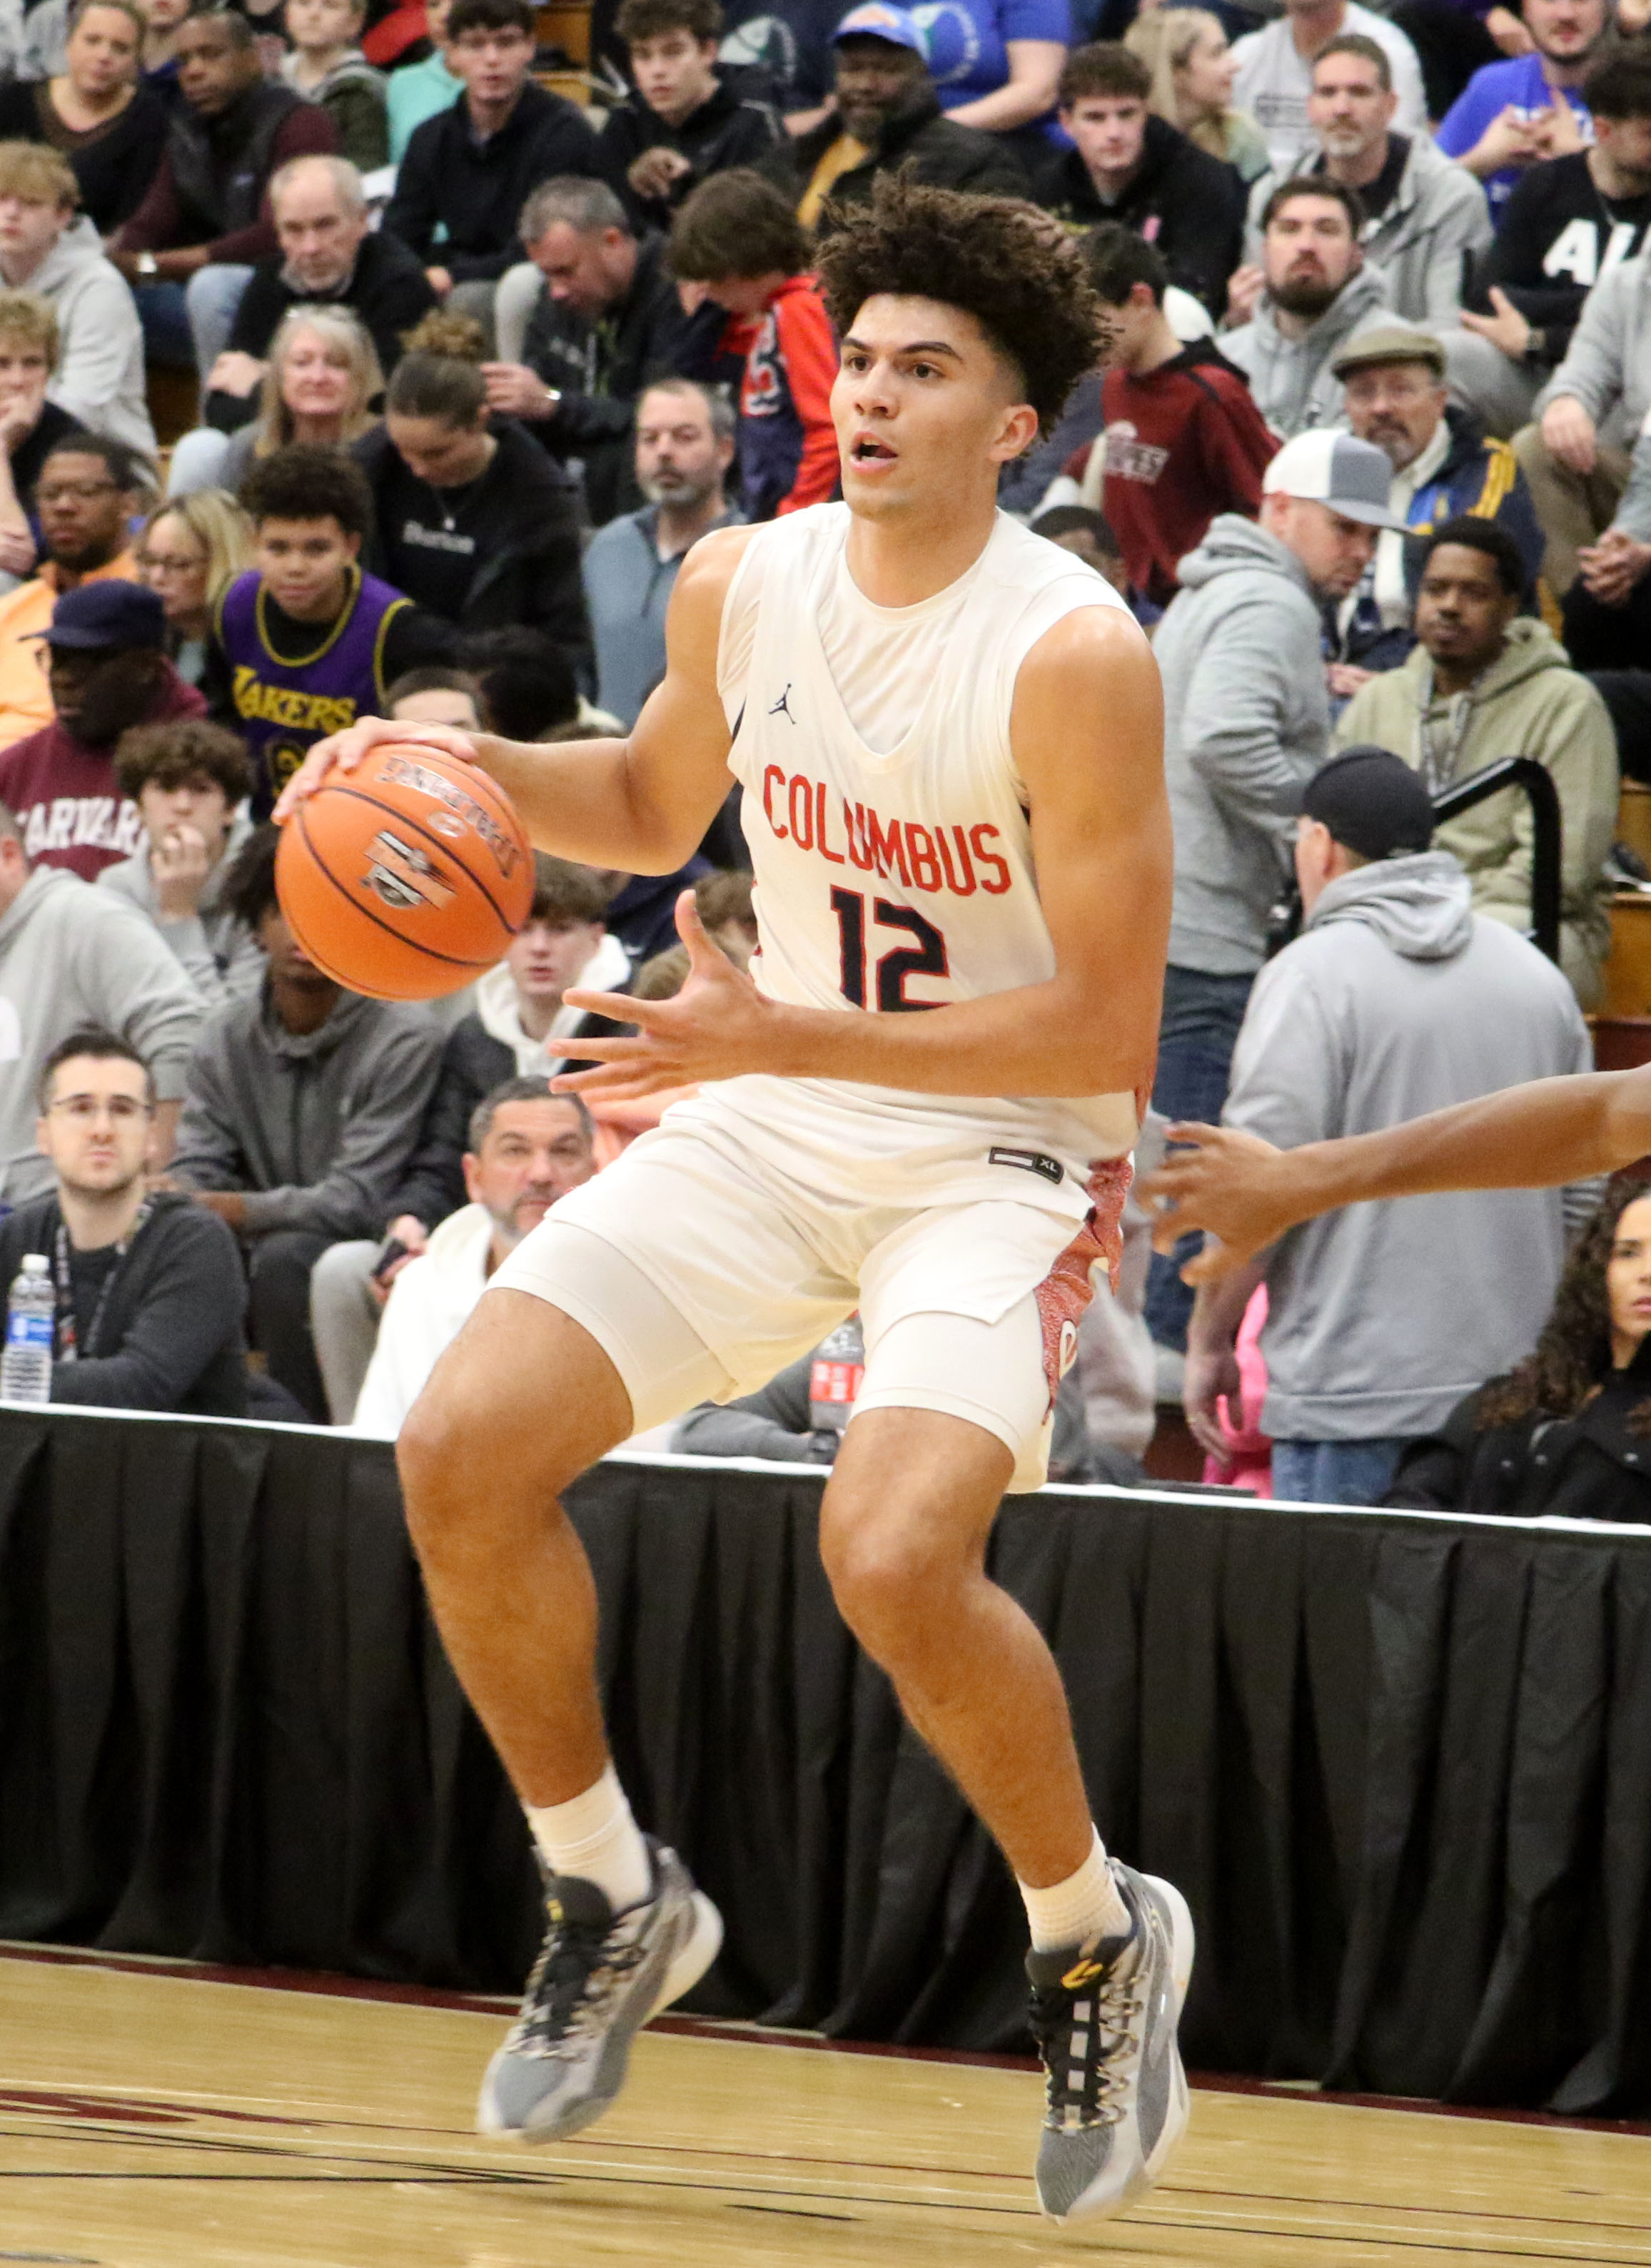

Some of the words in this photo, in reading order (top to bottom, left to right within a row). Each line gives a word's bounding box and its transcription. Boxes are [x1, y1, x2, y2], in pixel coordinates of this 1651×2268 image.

[233, 665, 355, 736] LAKERS
[15, 797, 140, 857] ARVAR
[764, 764, 1011, 896] COLUMBUS
[830, 884, 954, 1013] 12
[1040, 1158, 1057, 1173] XL
